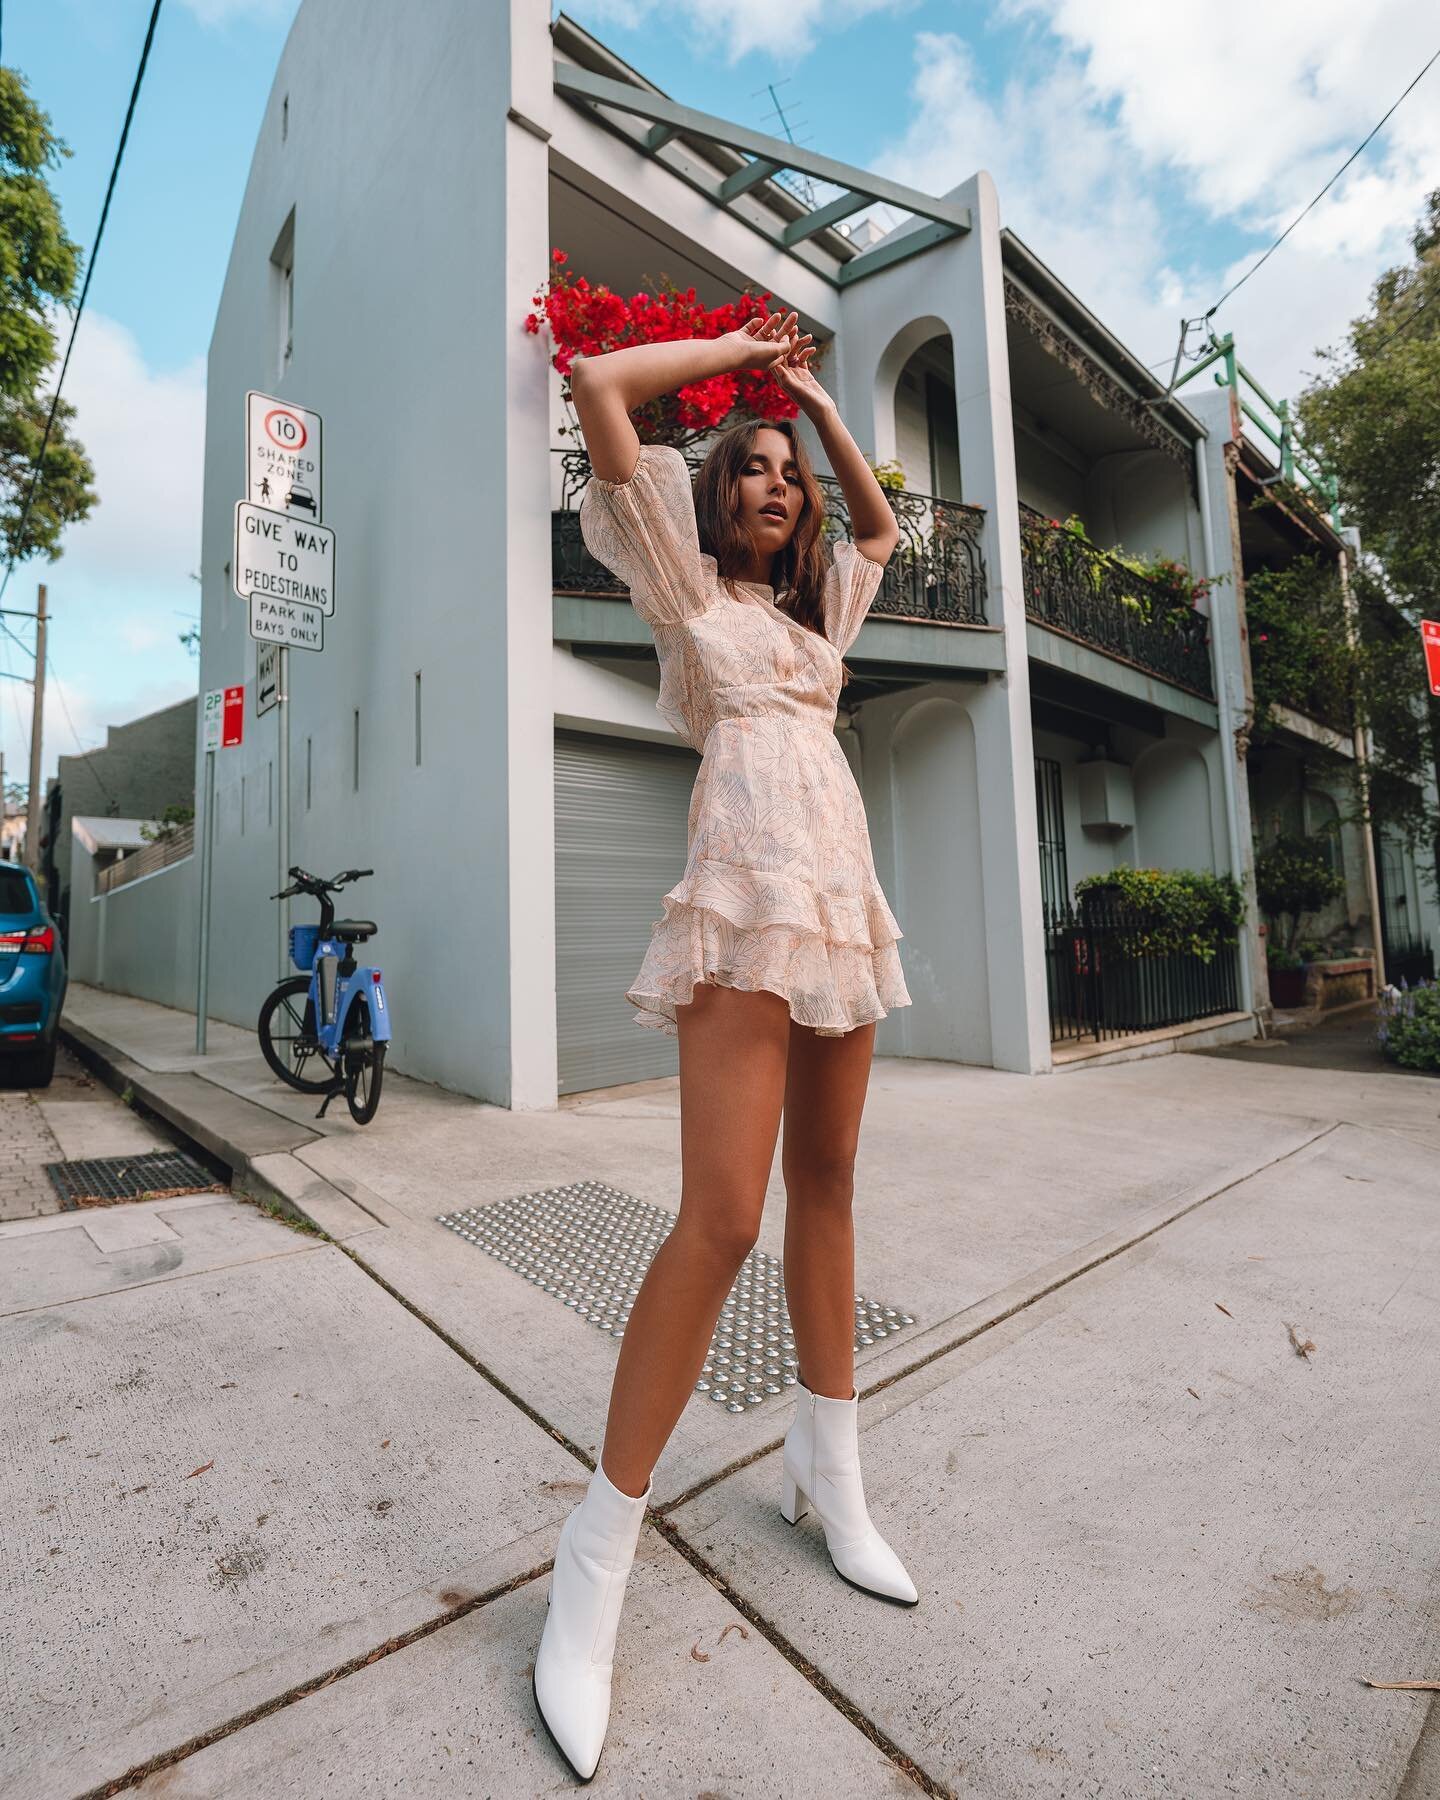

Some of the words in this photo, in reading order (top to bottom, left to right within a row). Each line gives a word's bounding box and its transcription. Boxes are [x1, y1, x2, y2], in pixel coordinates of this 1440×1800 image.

[277, 420, 296, 440] 10
[257, 447, 315, 472] SHARED
[267, 463, 304, 483] ZONE
[245, 516, 282, 542] GIVE
[295, 530, 328, 554] WAY
[278, 551, 298, 571] TO
[245, 568, 327, 605] PEDESTRIANS
[260, 602, 296, 620] PARK
[302, 612, 314, 624] IN
[256, 620, 284, 635] BAYS
[290, 628, 318, 642] ONLY
[260, 653, 275, 680] WAY
[206, 694, 222, 710] 2P
